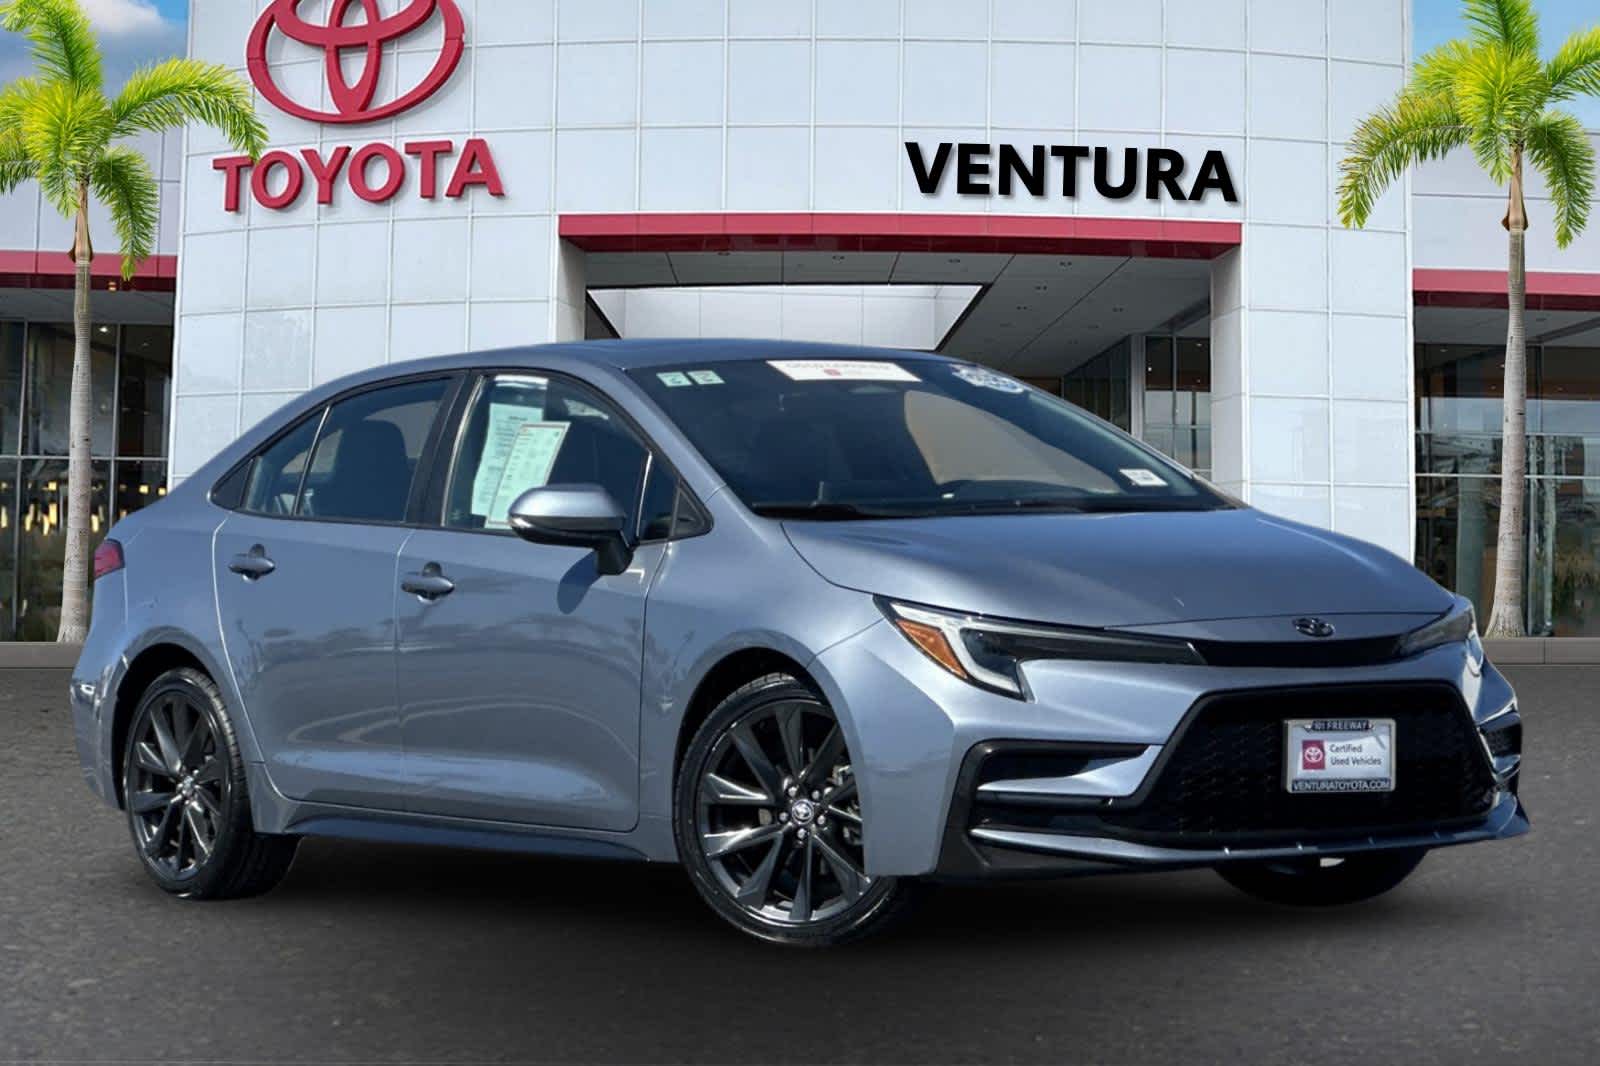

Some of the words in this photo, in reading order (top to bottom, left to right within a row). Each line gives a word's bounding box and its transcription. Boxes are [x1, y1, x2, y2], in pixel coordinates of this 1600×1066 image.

[213, 139, 504, 212] TOYOTA
[904, 142, 1239, 203] VENTURA
[1327, 720, 1367, 730] FREEWAY
[1330, 743, 1363, 753] Certified
[1330, 757, 1349, 766] Used
[1351, 757, 1382, 767] Vehicles
[1293, 780, 1390, 791] VENTURATOYOTA.COM
